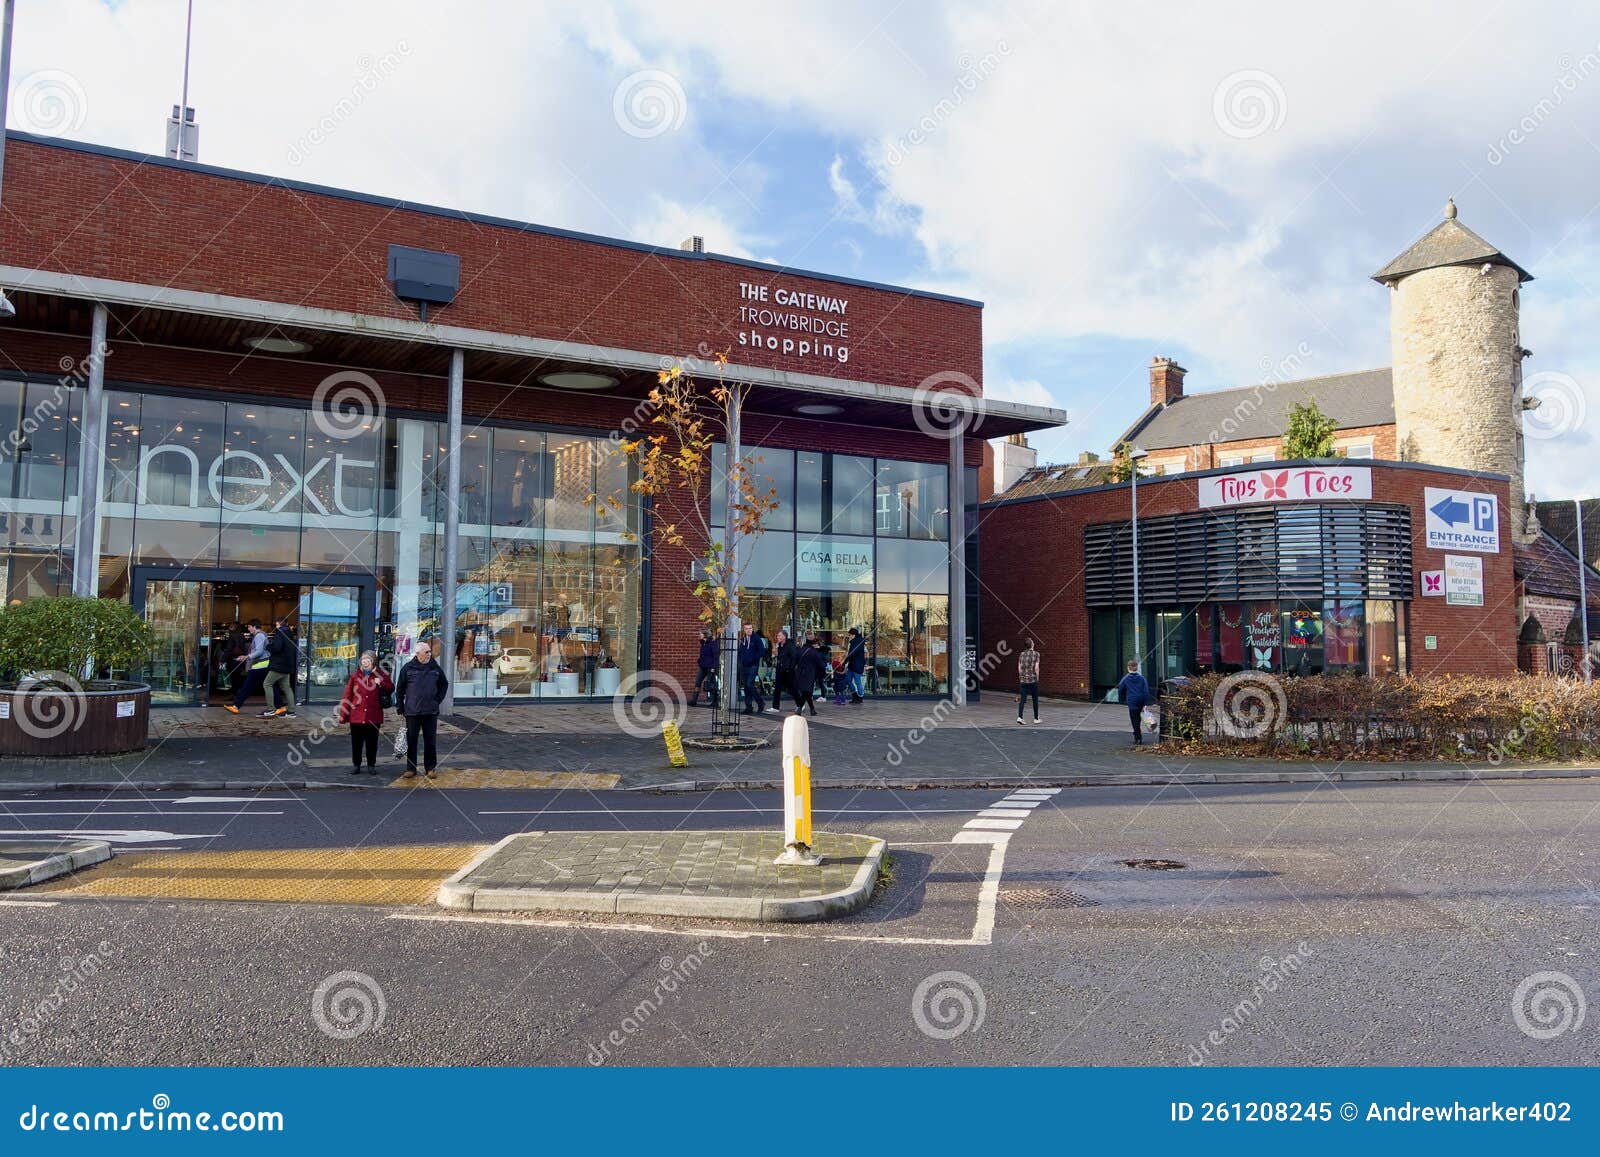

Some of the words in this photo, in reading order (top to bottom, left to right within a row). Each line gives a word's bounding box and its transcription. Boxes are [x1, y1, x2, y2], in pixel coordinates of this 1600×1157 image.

[740, 283, 768, 302] THE
[775, 289, 848, 314] GATEWAY
[740, 306, 849, 338] TROWBRIDGE
[739, 330, 848, 363] shopping
[137, 444, 375, 518] next
[1214, 477, 1257, 503] Tips
[1295, 470, 1353, 497] Toes
[1477, 500, 1492, 530] P
[1429, 531, 1496, 545] ENTRANCE
[801, 551, 832, 564] CASA
[836, 553, 869, 566] BELLA
[1255, 612, 1274, 626] Gift
[1290, 610, 1314, 618] OPEN
[1245, 624, 1280, 636] Vouchers
[1246, 635, 1280, 647] Available
